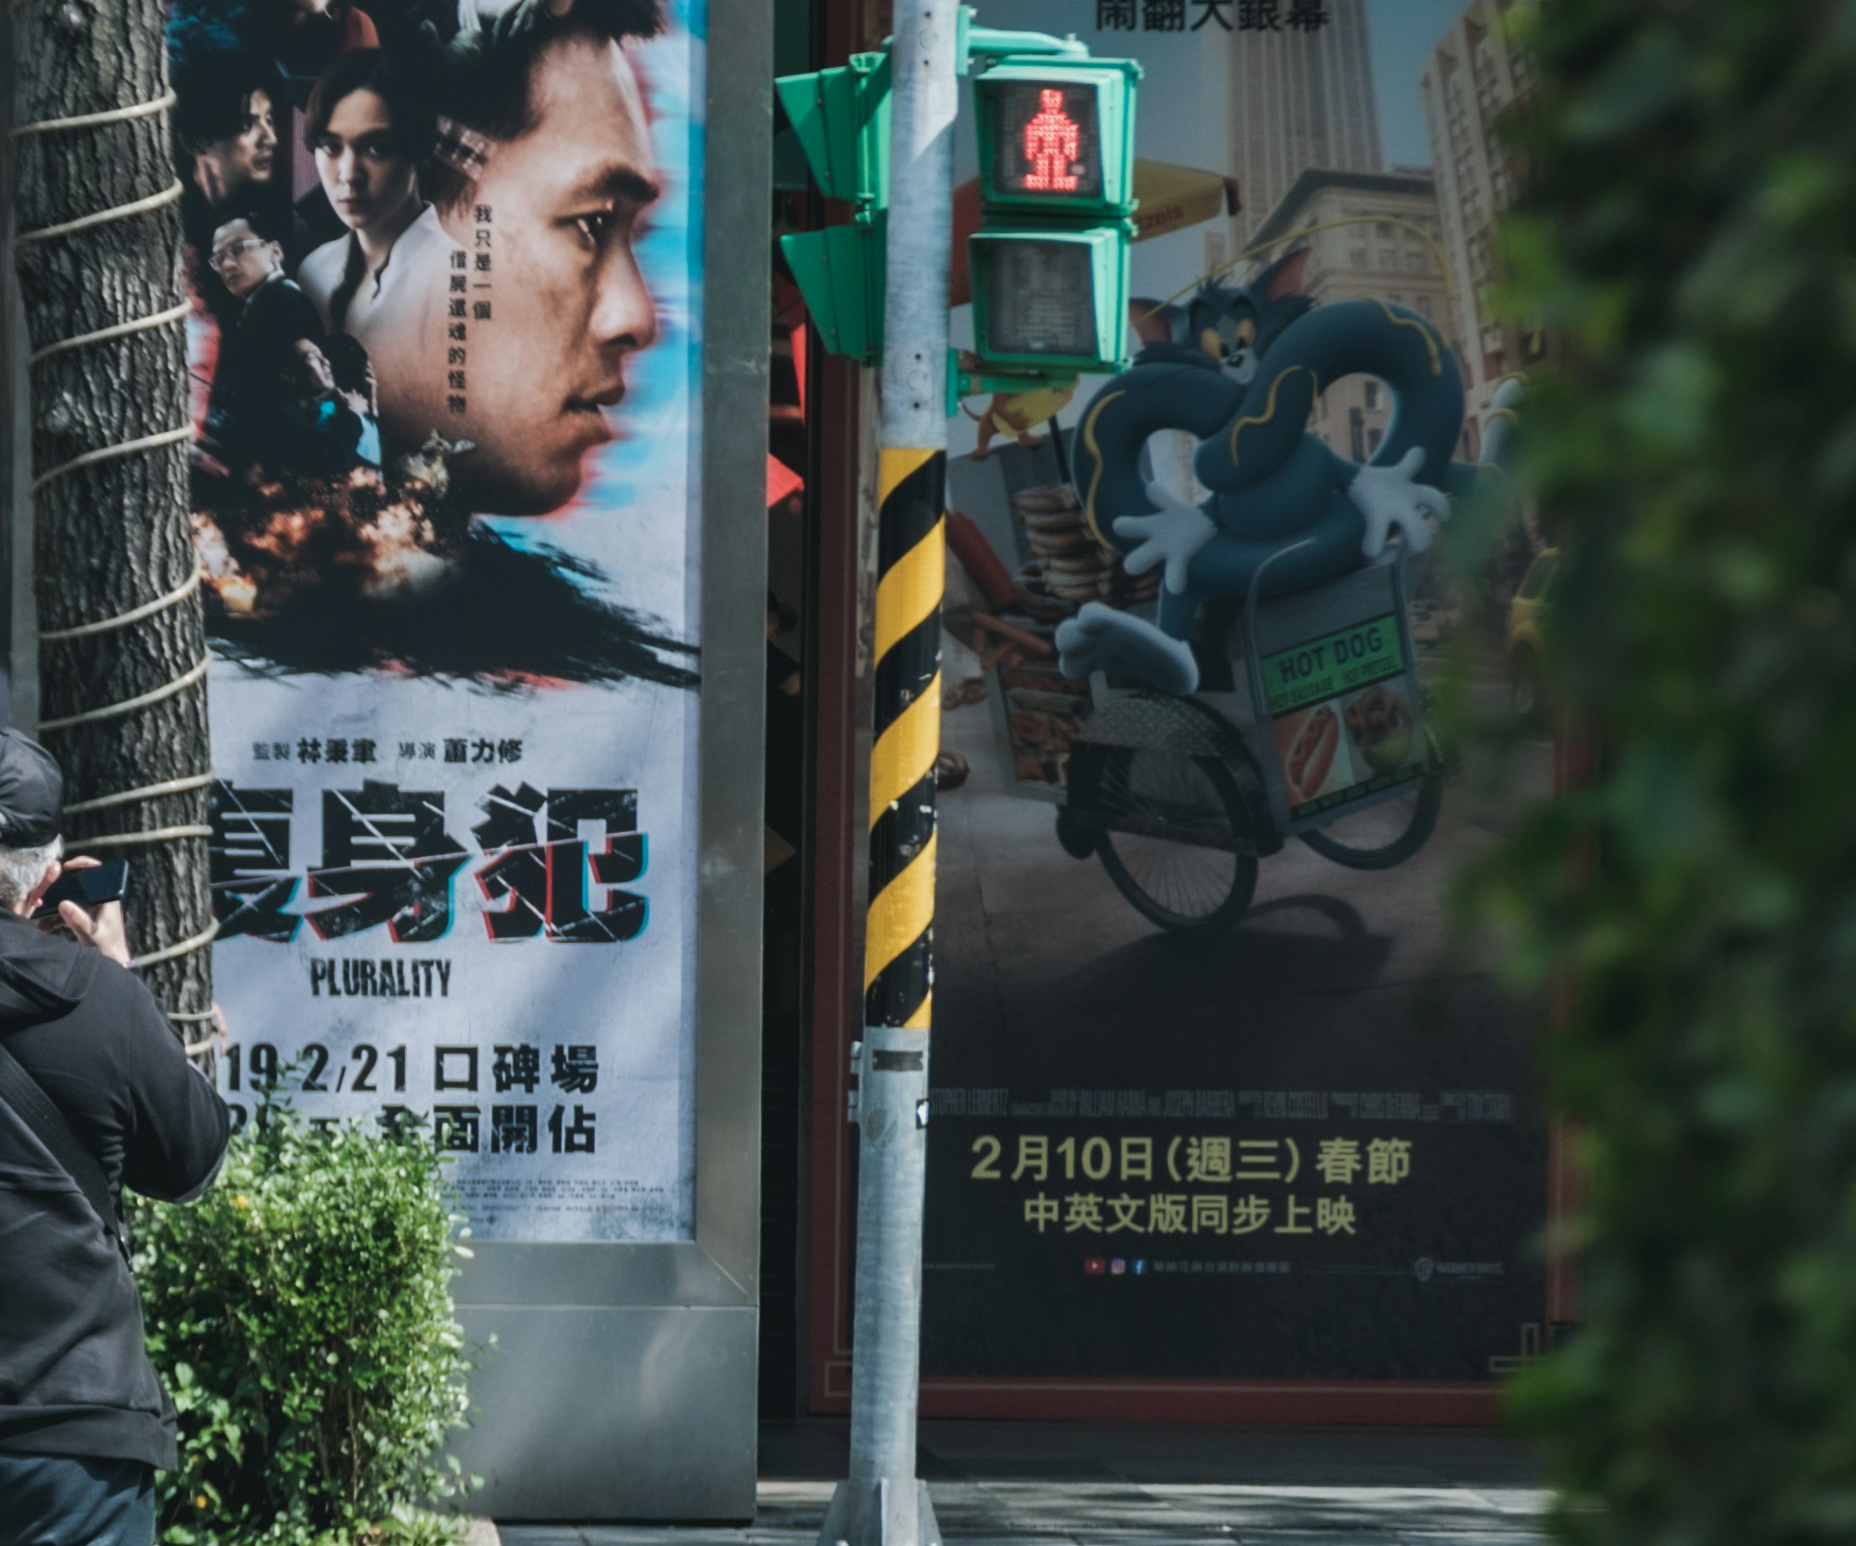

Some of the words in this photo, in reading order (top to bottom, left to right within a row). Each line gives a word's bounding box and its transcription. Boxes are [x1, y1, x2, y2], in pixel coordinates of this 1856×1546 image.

[472, 203, 492, 321] 我只是一個
[447, 249, 468, 414] 借屍還魂的怪物
[1279, 646, 1326, 685] HOT
[1333, 626, 1384, 665] DOG
[252, 741, 291, 762] 監製
[399, 741, 437, 761] 導演
[309, 957, 452, 998] PLURALITY
[433, 1044, 600, 1095] 口碑場
[1023, 1192, 1357, 1236] 中英文版同步上映
